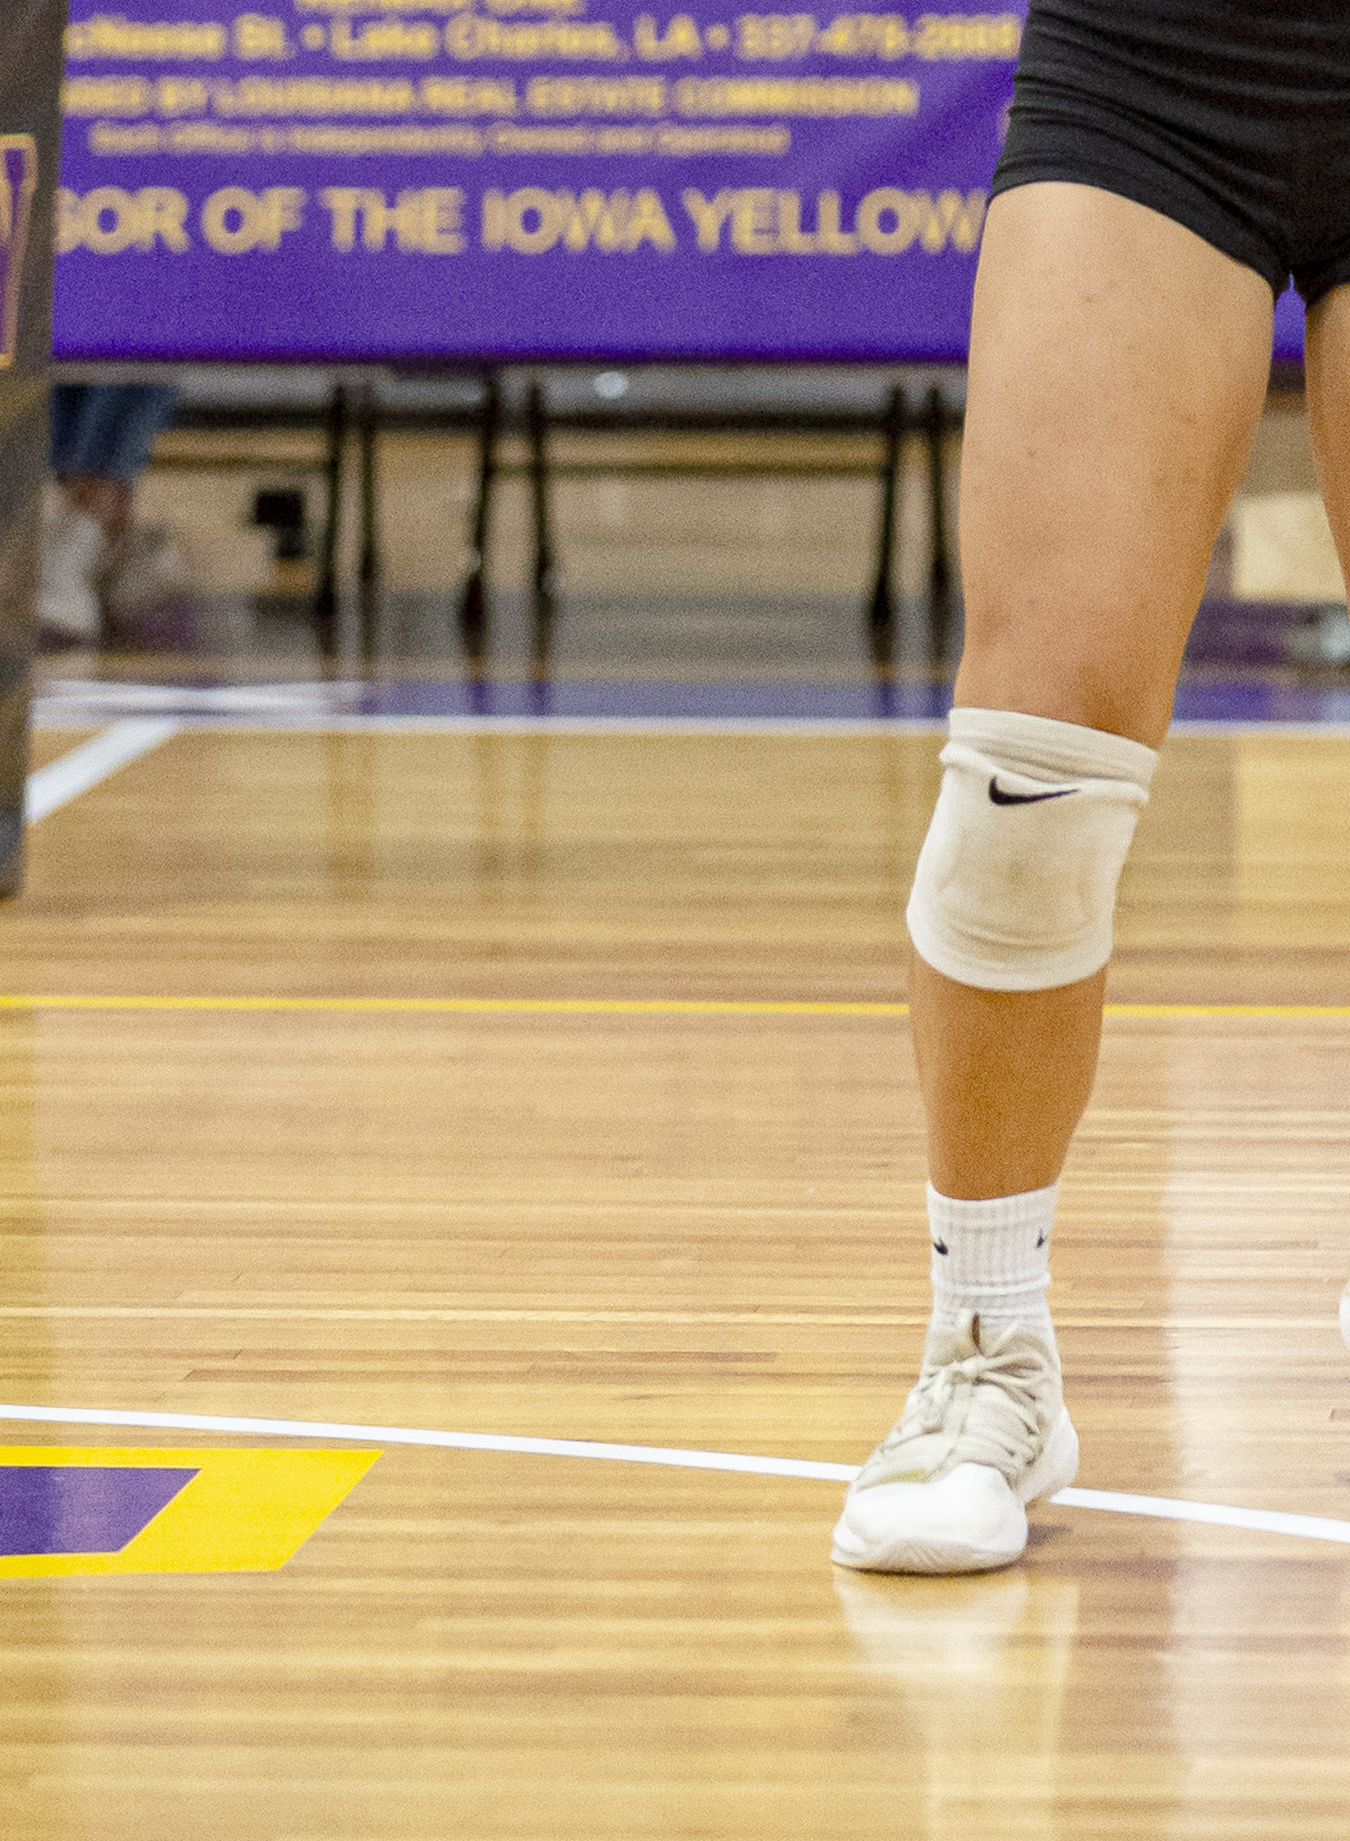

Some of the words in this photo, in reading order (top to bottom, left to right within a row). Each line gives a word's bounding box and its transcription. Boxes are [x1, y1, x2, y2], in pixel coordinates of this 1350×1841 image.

[203, 187, 304, 253] OF
[321, 187, 467, 253] THE
[482, 187, 677, 253] IOWA
[681, 187, 988, 254] YELLOW
